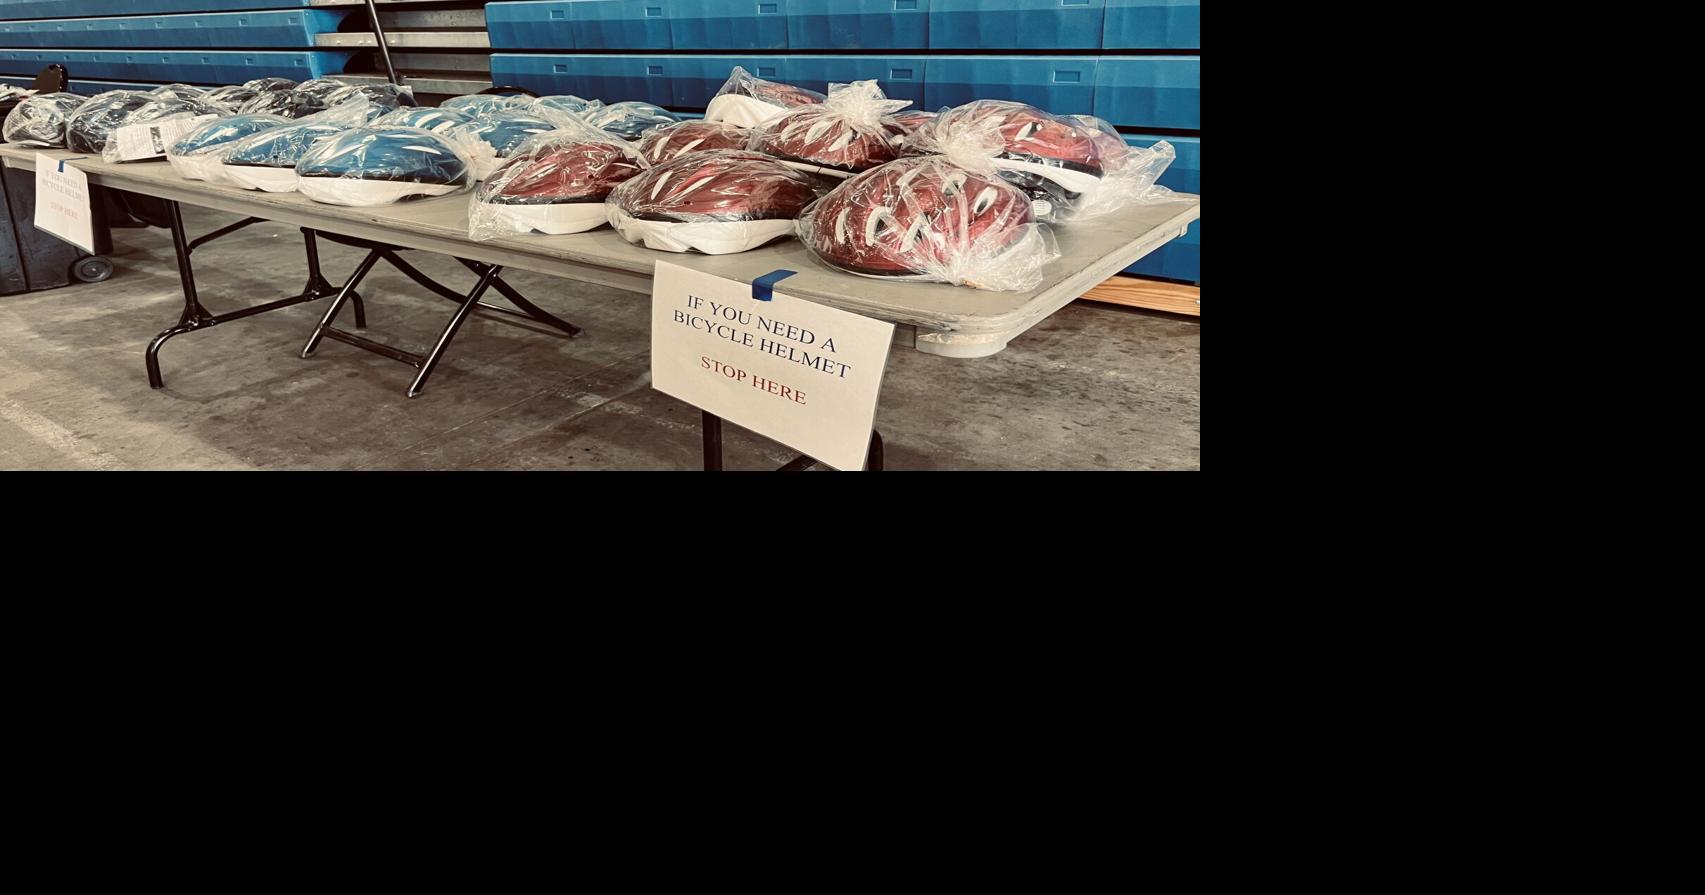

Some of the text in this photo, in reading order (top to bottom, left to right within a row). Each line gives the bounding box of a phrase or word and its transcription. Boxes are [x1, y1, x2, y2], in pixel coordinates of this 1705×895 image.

[674, 310, 852, 379] BICYCLE HELMET
[687, 295, 837, 353] IF YOU NEED A
[701, 356, 807, 405] STOP HERE
